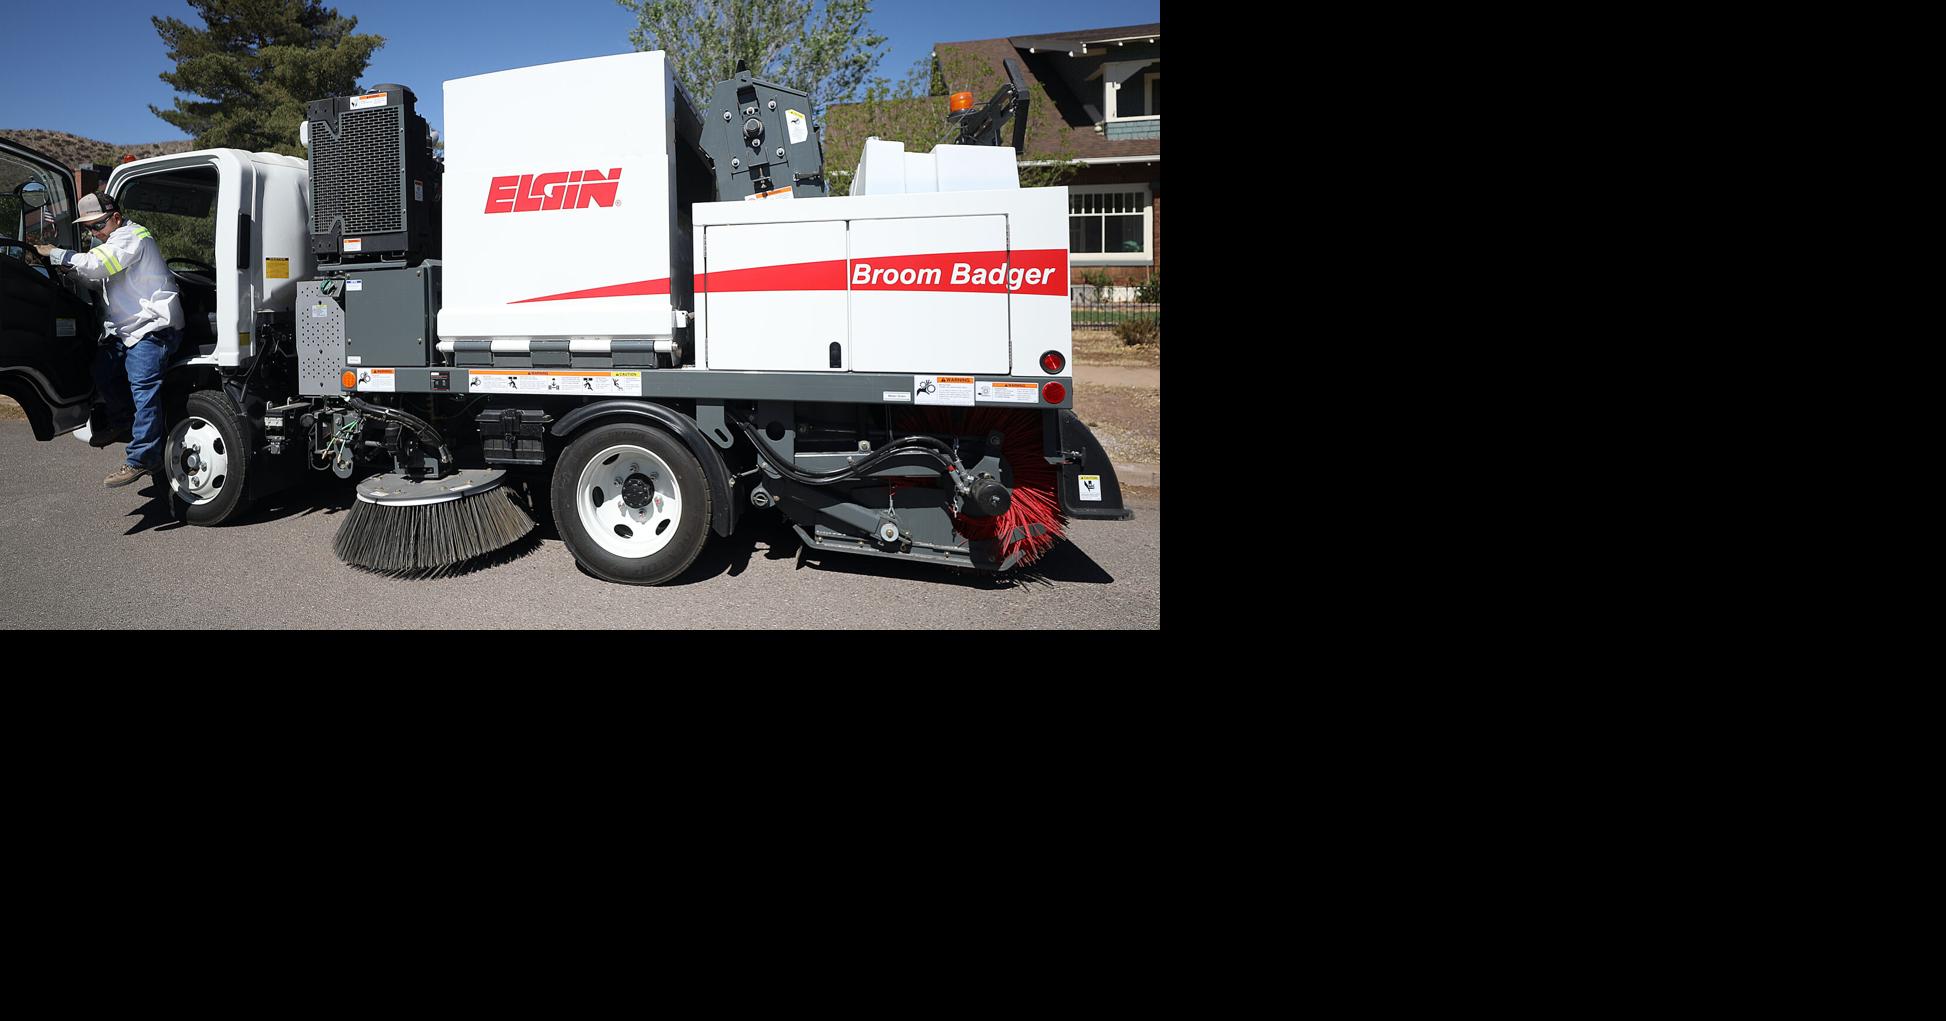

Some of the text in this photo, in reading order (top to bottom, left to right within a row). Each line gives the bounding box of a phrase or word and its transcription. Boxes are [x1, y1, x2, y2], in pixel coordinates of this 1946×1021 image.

[484, 167, 622, 214] ELGIN
[851, 262, 1056, 290] Broom Badger
